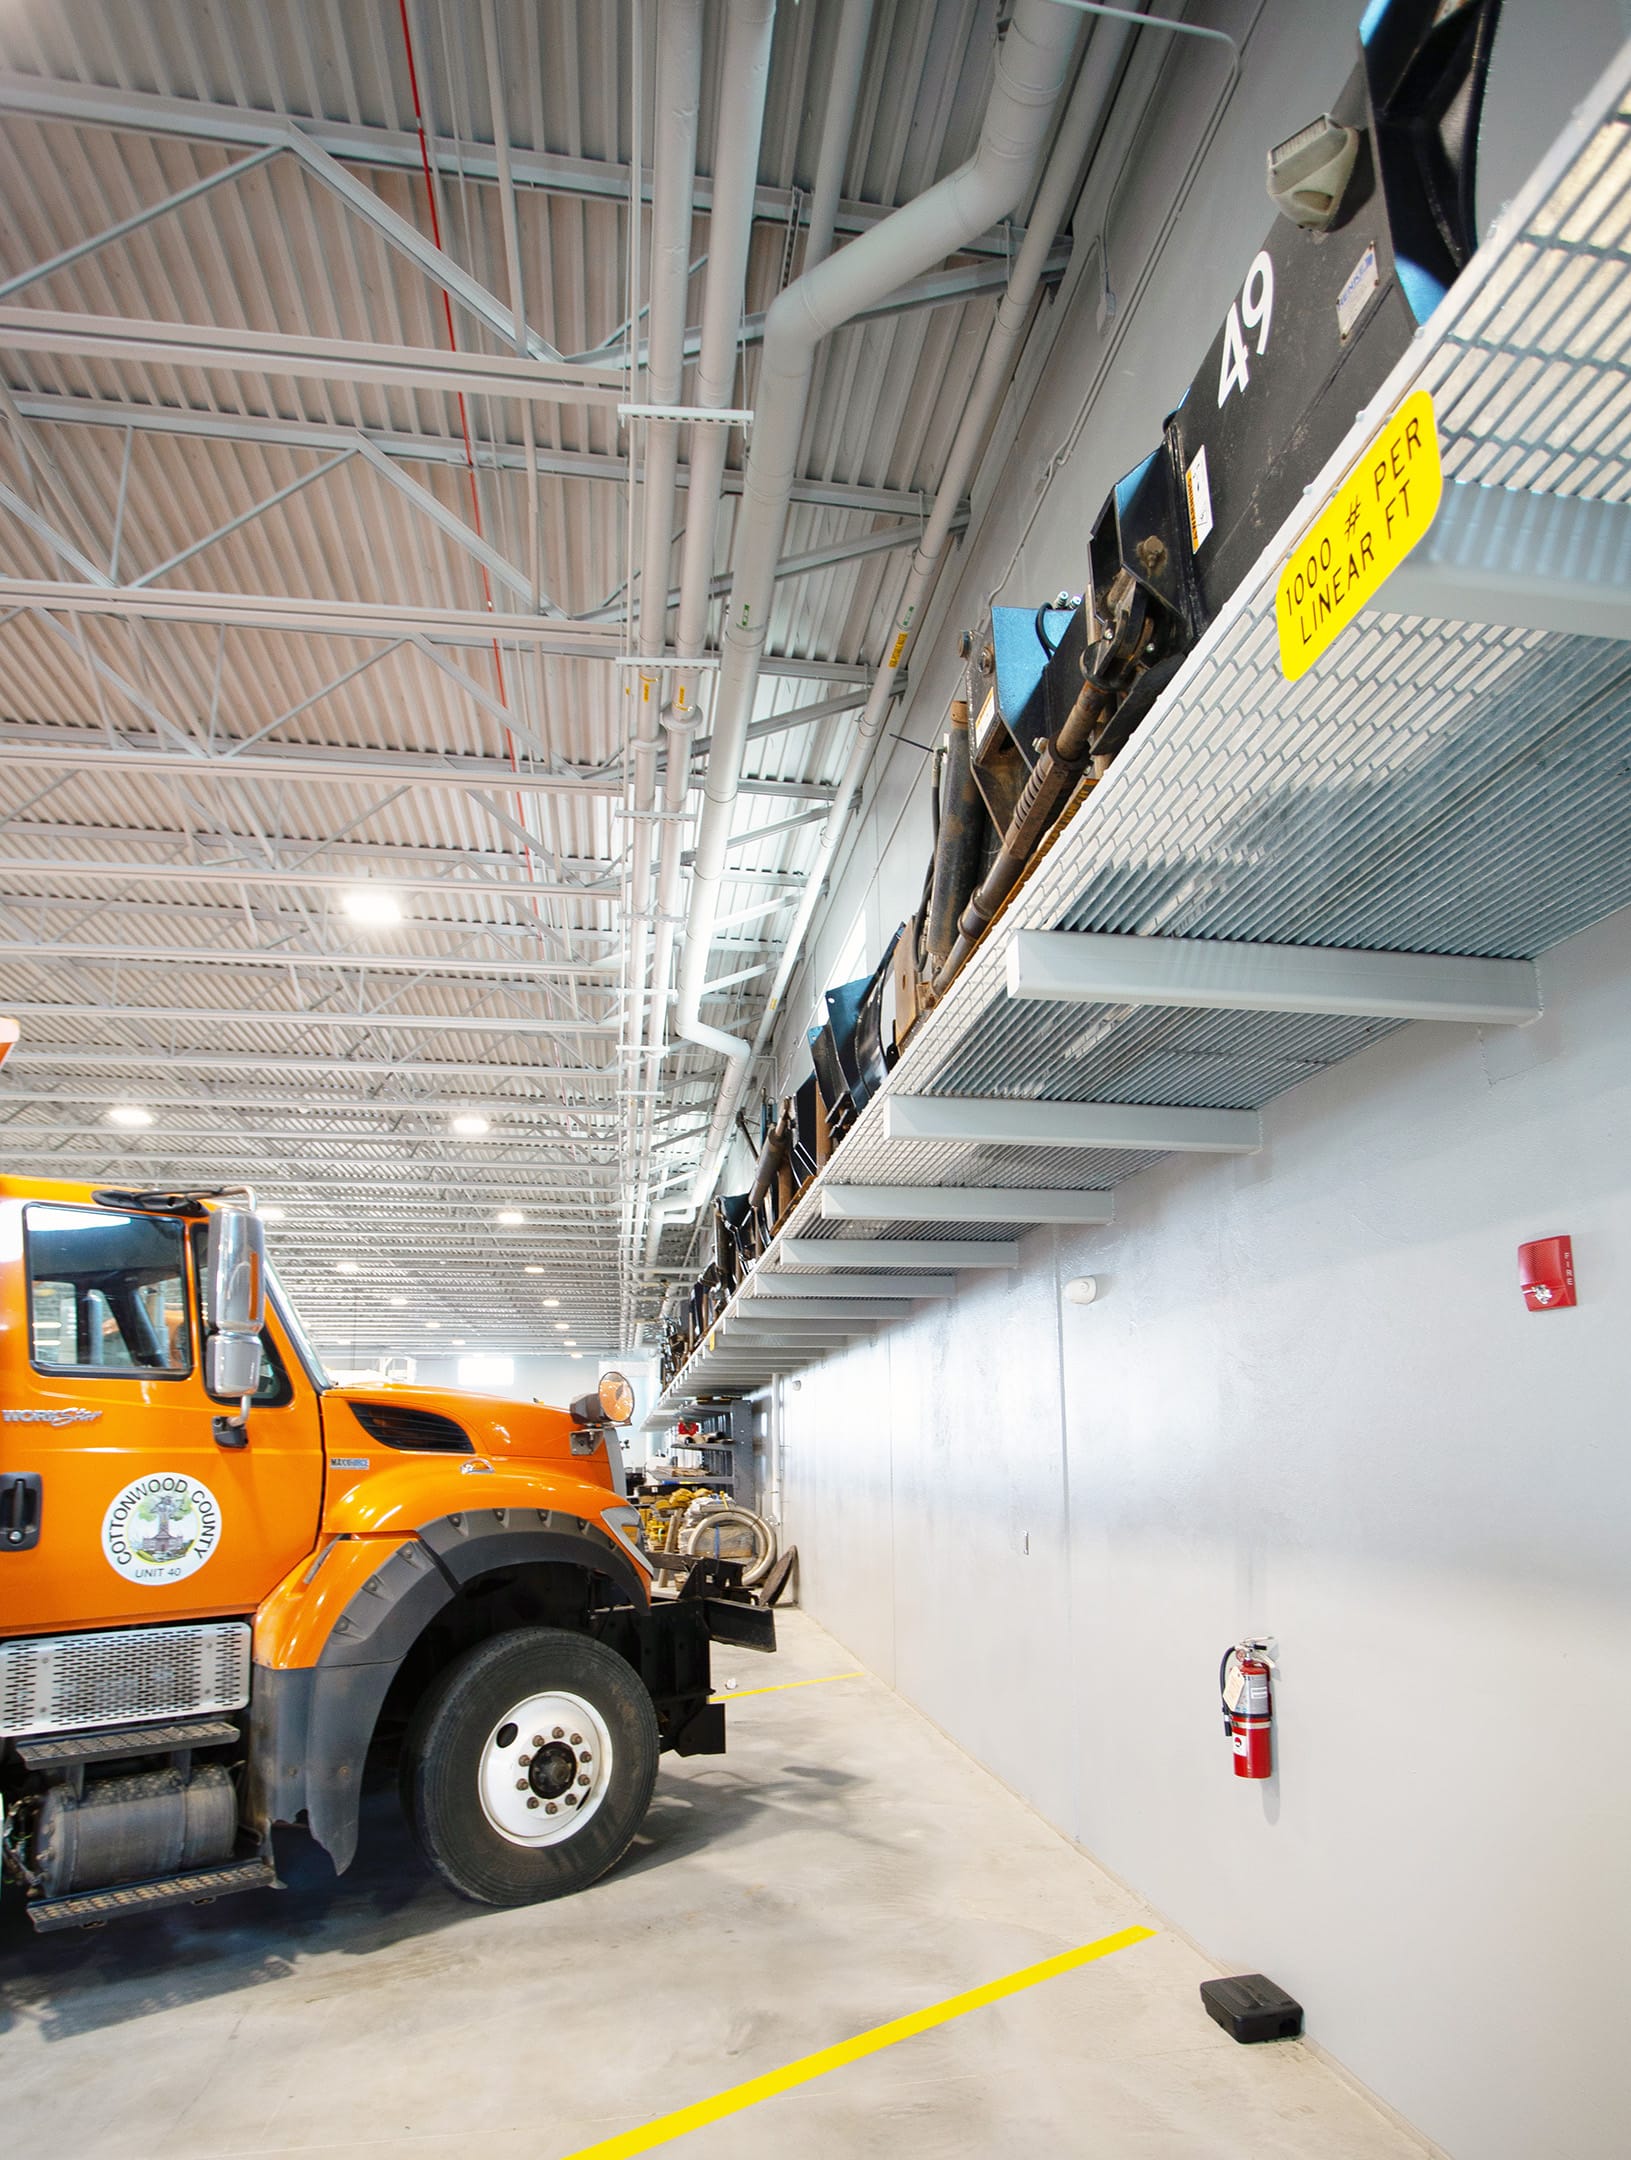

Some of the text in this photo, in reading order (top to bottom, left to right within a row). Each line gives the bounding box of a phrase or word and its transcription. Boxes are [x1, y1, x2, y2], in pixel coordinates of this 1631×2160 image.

[1217, 250, 1274, 409] 49
[1286, 417, 1422, 616] 1000 # PER
[1300, 479, 1410, 645] LINEAR FT
[1564, 1252, 1574, 1285] FIRE
[109, 1477, 216, 1565] COTTONWOOD COUNTY
[135, 1567, 181, 1578] UNIT 40
